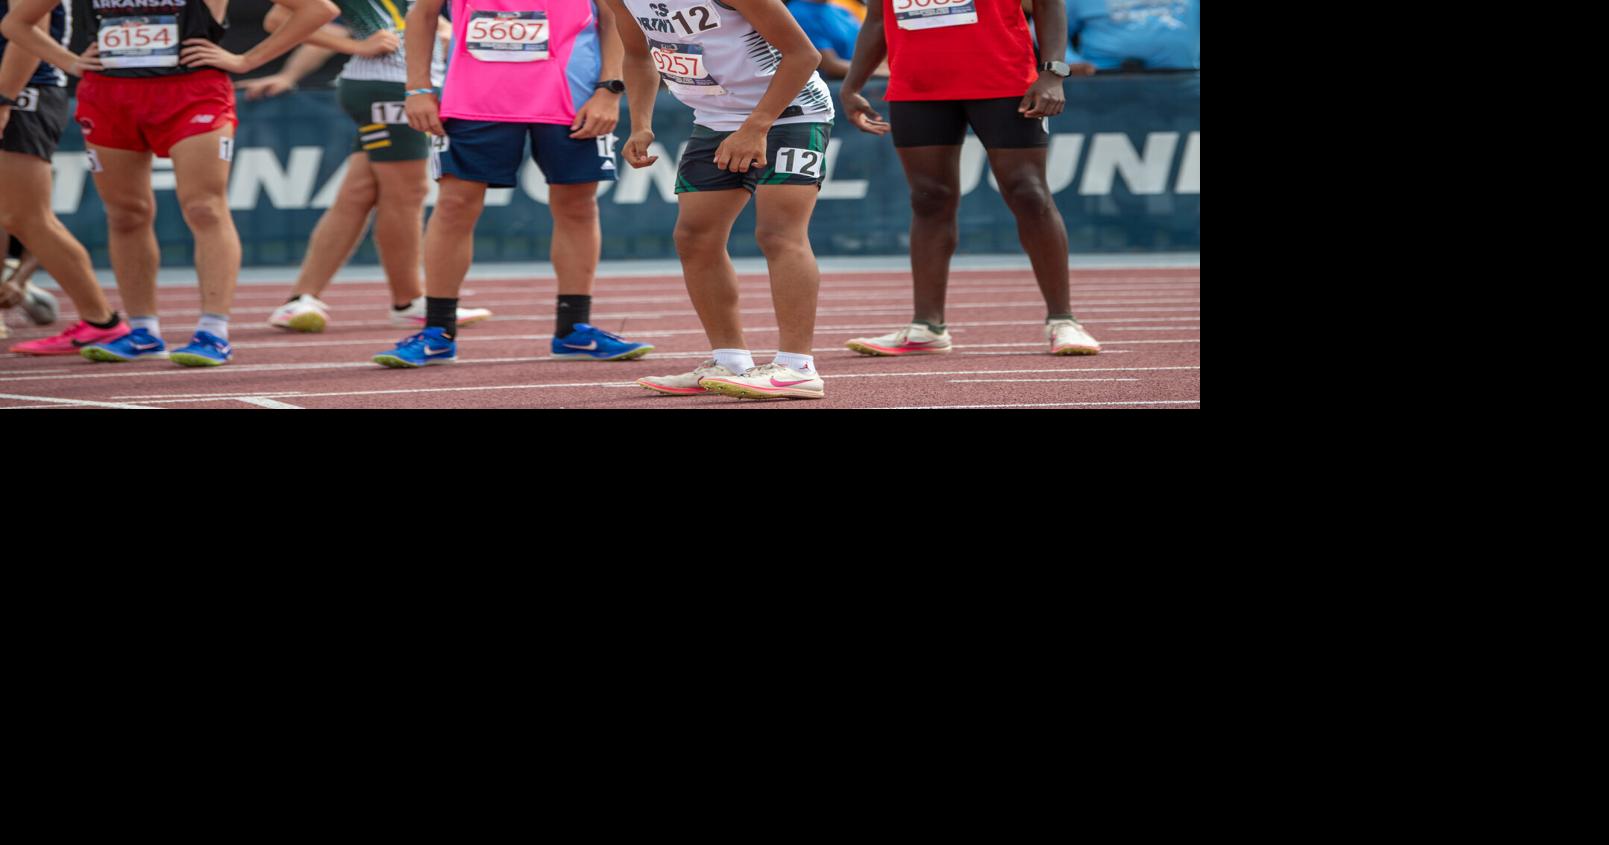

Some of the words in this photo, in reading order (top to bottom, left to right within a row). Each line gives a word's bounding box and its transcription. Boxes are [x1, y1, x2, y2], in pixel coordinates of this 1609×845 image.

[471, 21, 543, 40] 5607
[672, 6, 718, 34] 12
[104, 27, 171, 48] 6154
[653, 51, 698, 76] 9257
[374, 104, 405, 122] 17
[781, 149, 818, 176] 12
